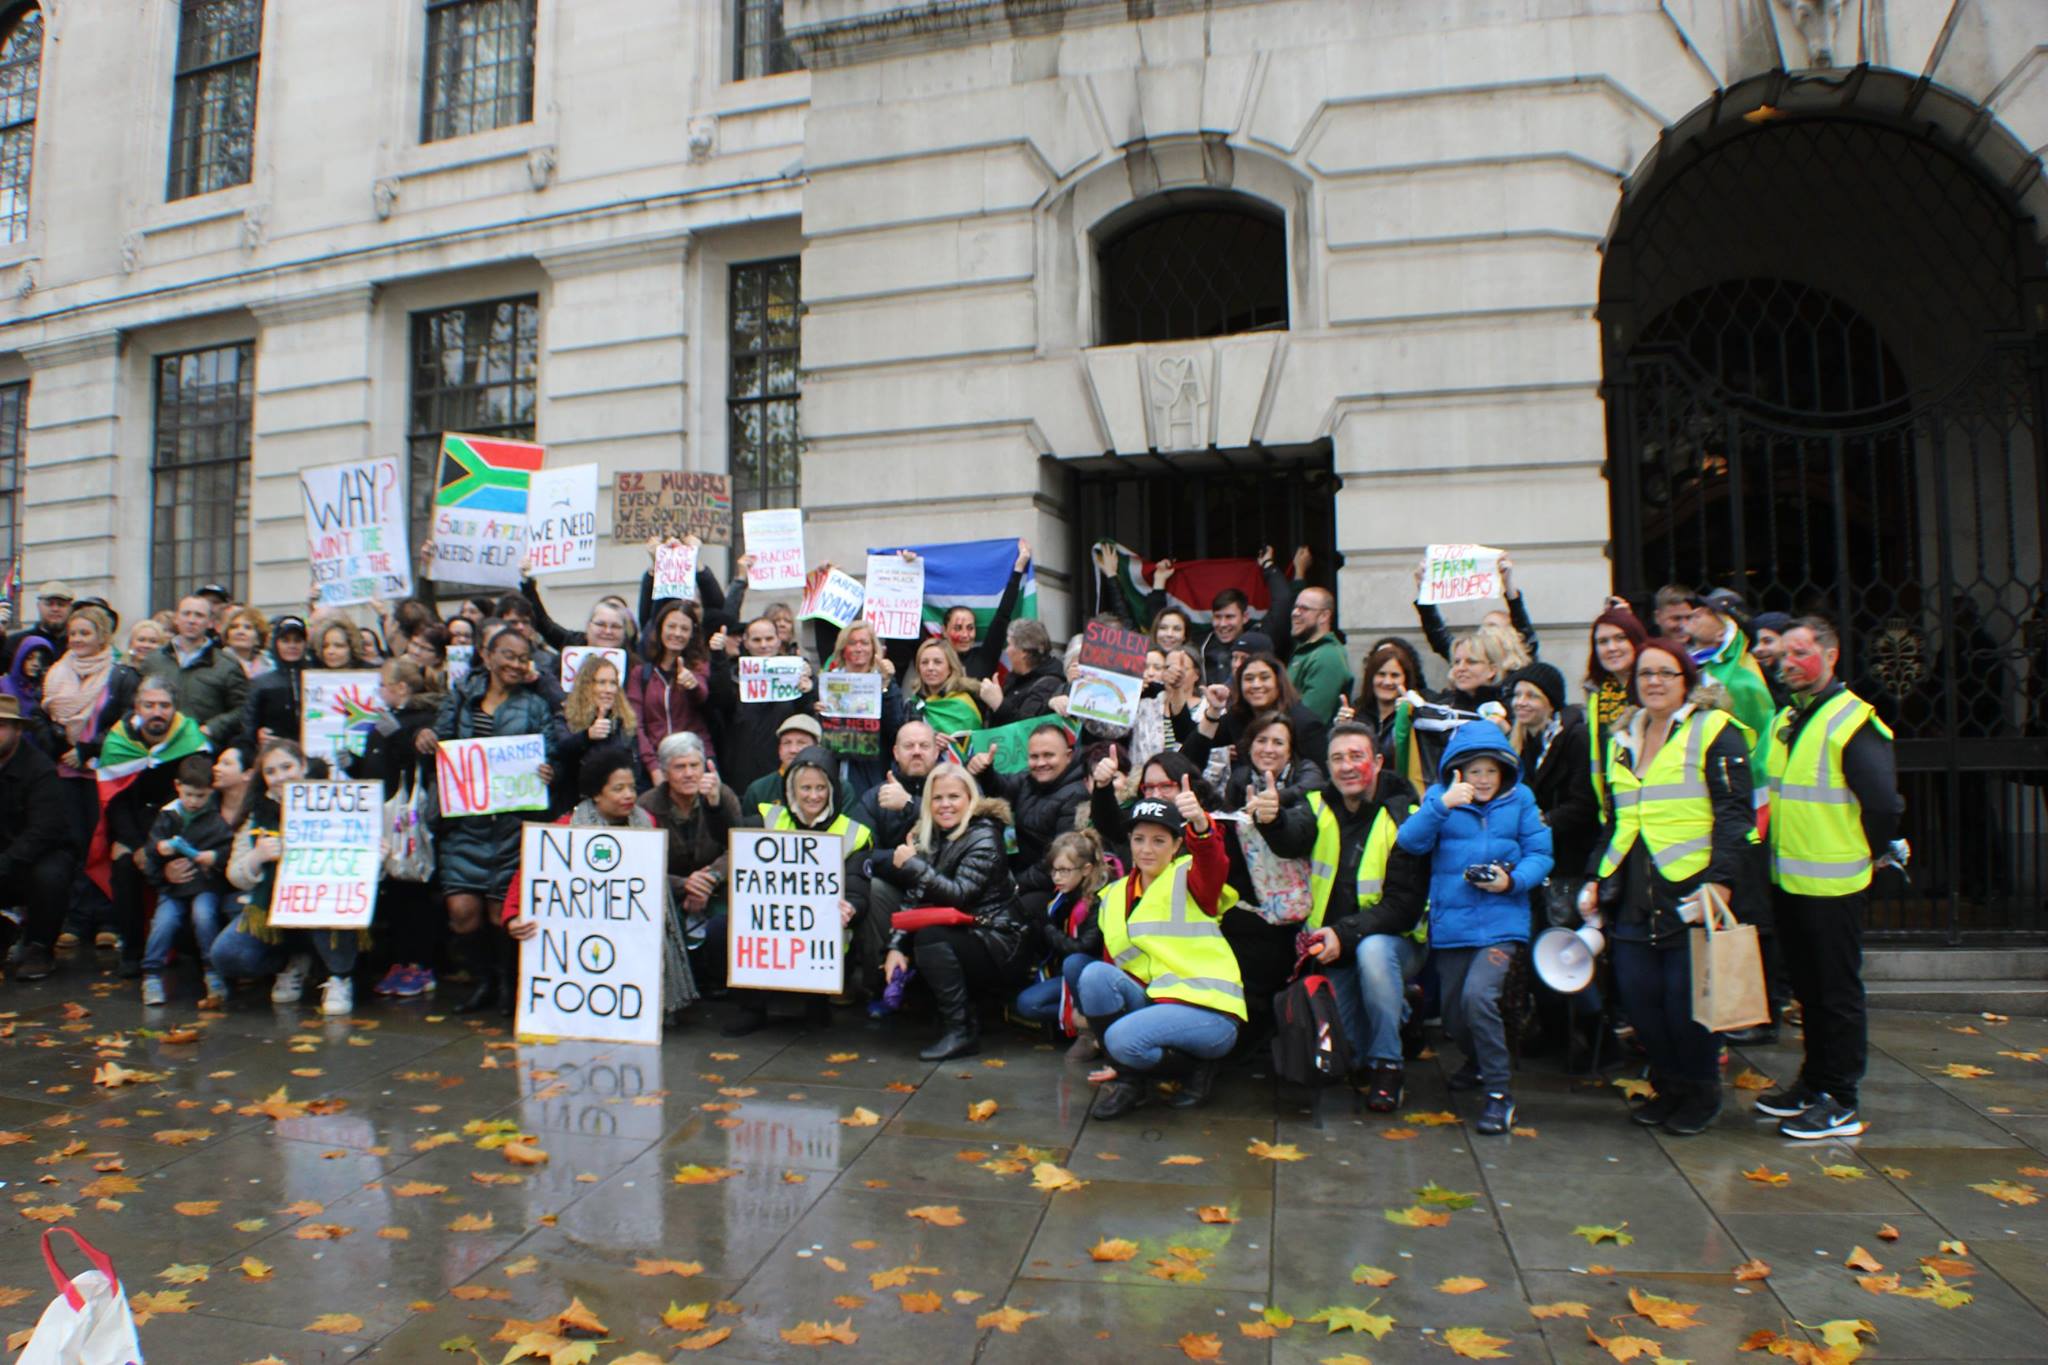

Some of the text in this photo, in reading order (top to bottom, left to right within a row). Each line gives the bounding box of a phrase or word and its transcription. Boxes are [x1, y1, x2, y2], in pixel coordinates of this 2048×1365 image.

[661, 471, 726, 494] MURDERS
[301, 463, 396, 530] WHY?
[619, 491, 660, 507] EVERY
[530, 511, 594, 542] WE NEED
[620, 508, 644, 522] WE
[652, 506, 688, 522] SOUTH
[480, 545, 516, 567] HELP
[1432, 558, 1476, 578] FARM
[866, 609, 919, 636] MATTER
[1087, 622, 1150, 653] STOLEN
[748, 679, 767, 699] NO
[846, 718, 881, 732] NEED
[436, 741, 544, 814] NO FARMER
[492, 772, 544, 799] FOOD
[292, 785, 370, 812] PLEASE
[286, 819, 371, 844] STEP IN
[284, 849, 368, 877] PLEASE
[540, 830, 622, 872] NO
[754, 836, 820, 865] OUR
[735, 869, 840, 896] FARMERS
[277, 882, 369, 914] HELP US
[531, 877, 650, 922] FARMER
[751, 904, 815, 932] NEED
[541, 928, 616, 974] NO
[530, 976, 643, 1020] FOOD
